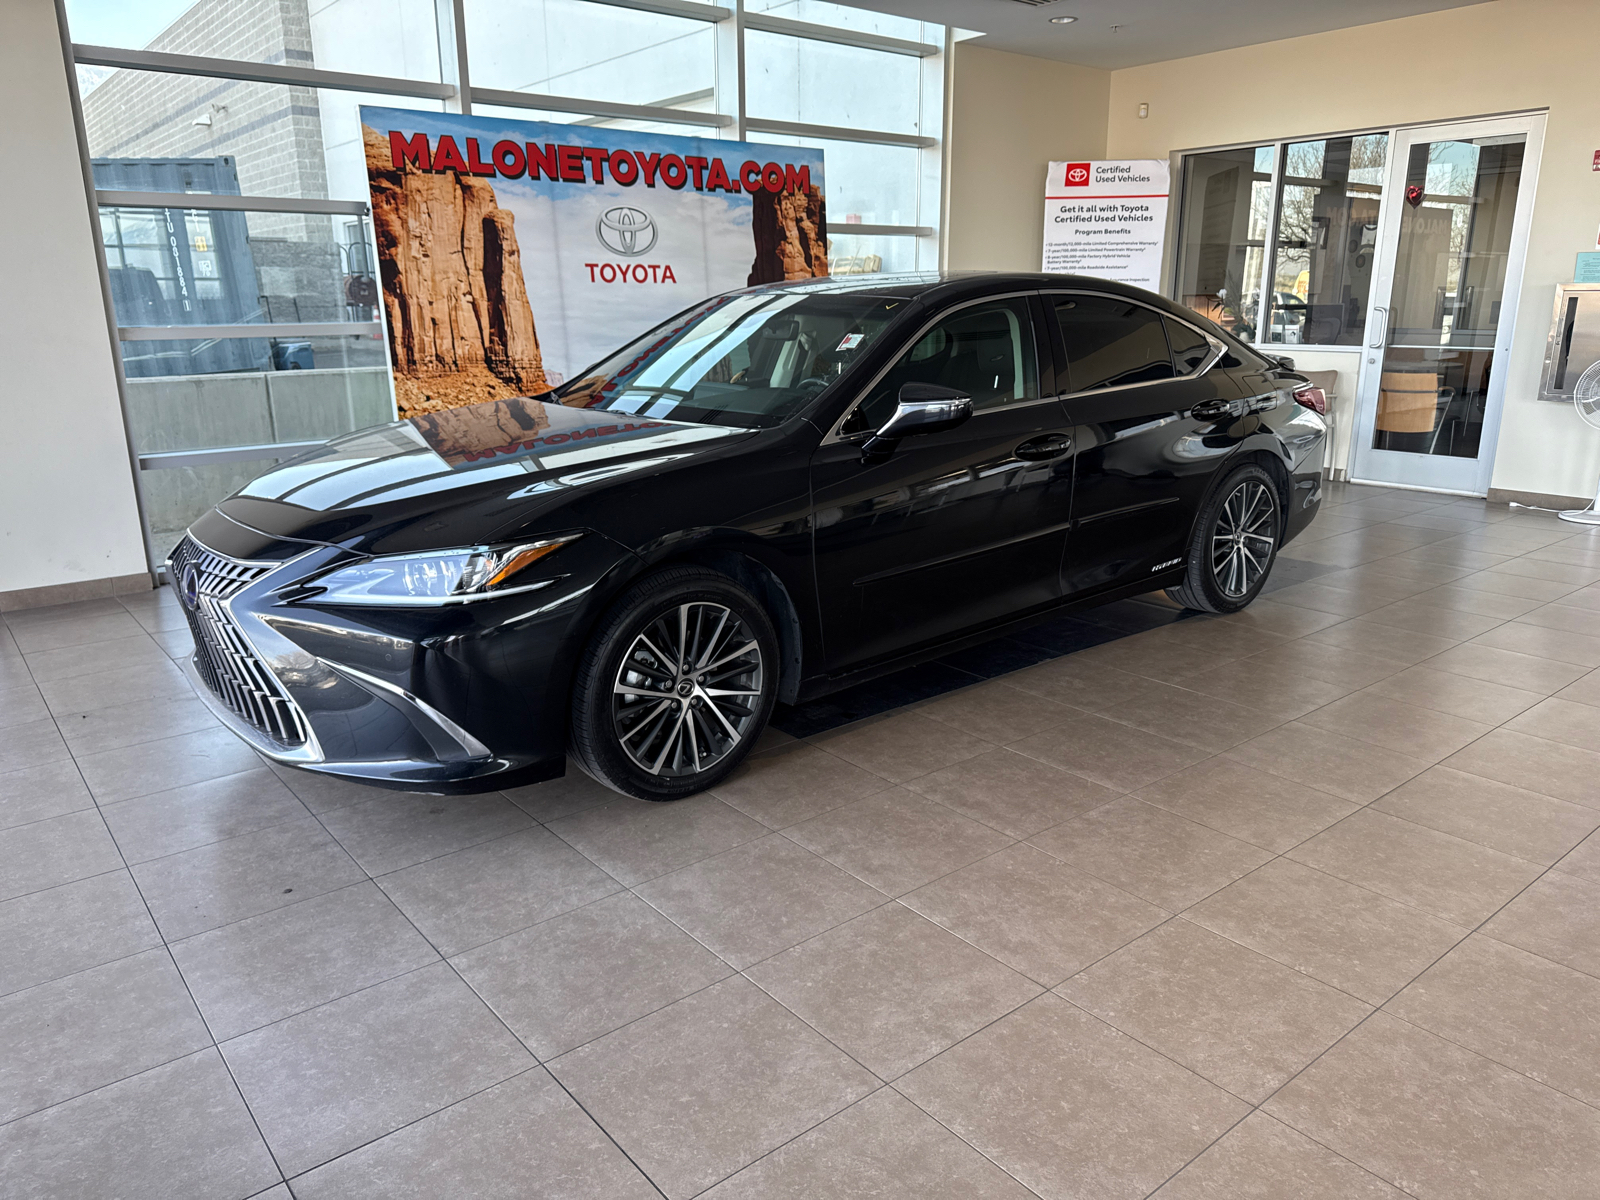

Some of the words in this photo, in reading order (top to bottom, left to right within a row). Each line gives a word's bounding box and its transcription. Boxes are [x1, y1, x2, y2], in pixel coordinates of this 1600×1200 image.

[388, 130, 811, 195] MALONETOYOTA.COM
[1096, 166, 1131, 174] Certified
[1095, 175, 1116, 183] Used
[1099, 204, 1118, 212] with
[1120, 204, 1149, 213] Toyota
[1054, 215, 1092, 223] Certified
[1094, 214, 1116, 222] Used
[1118, 214, 1153, 222] Vehicles
[585, 263, 677, 284] TOYOTA
